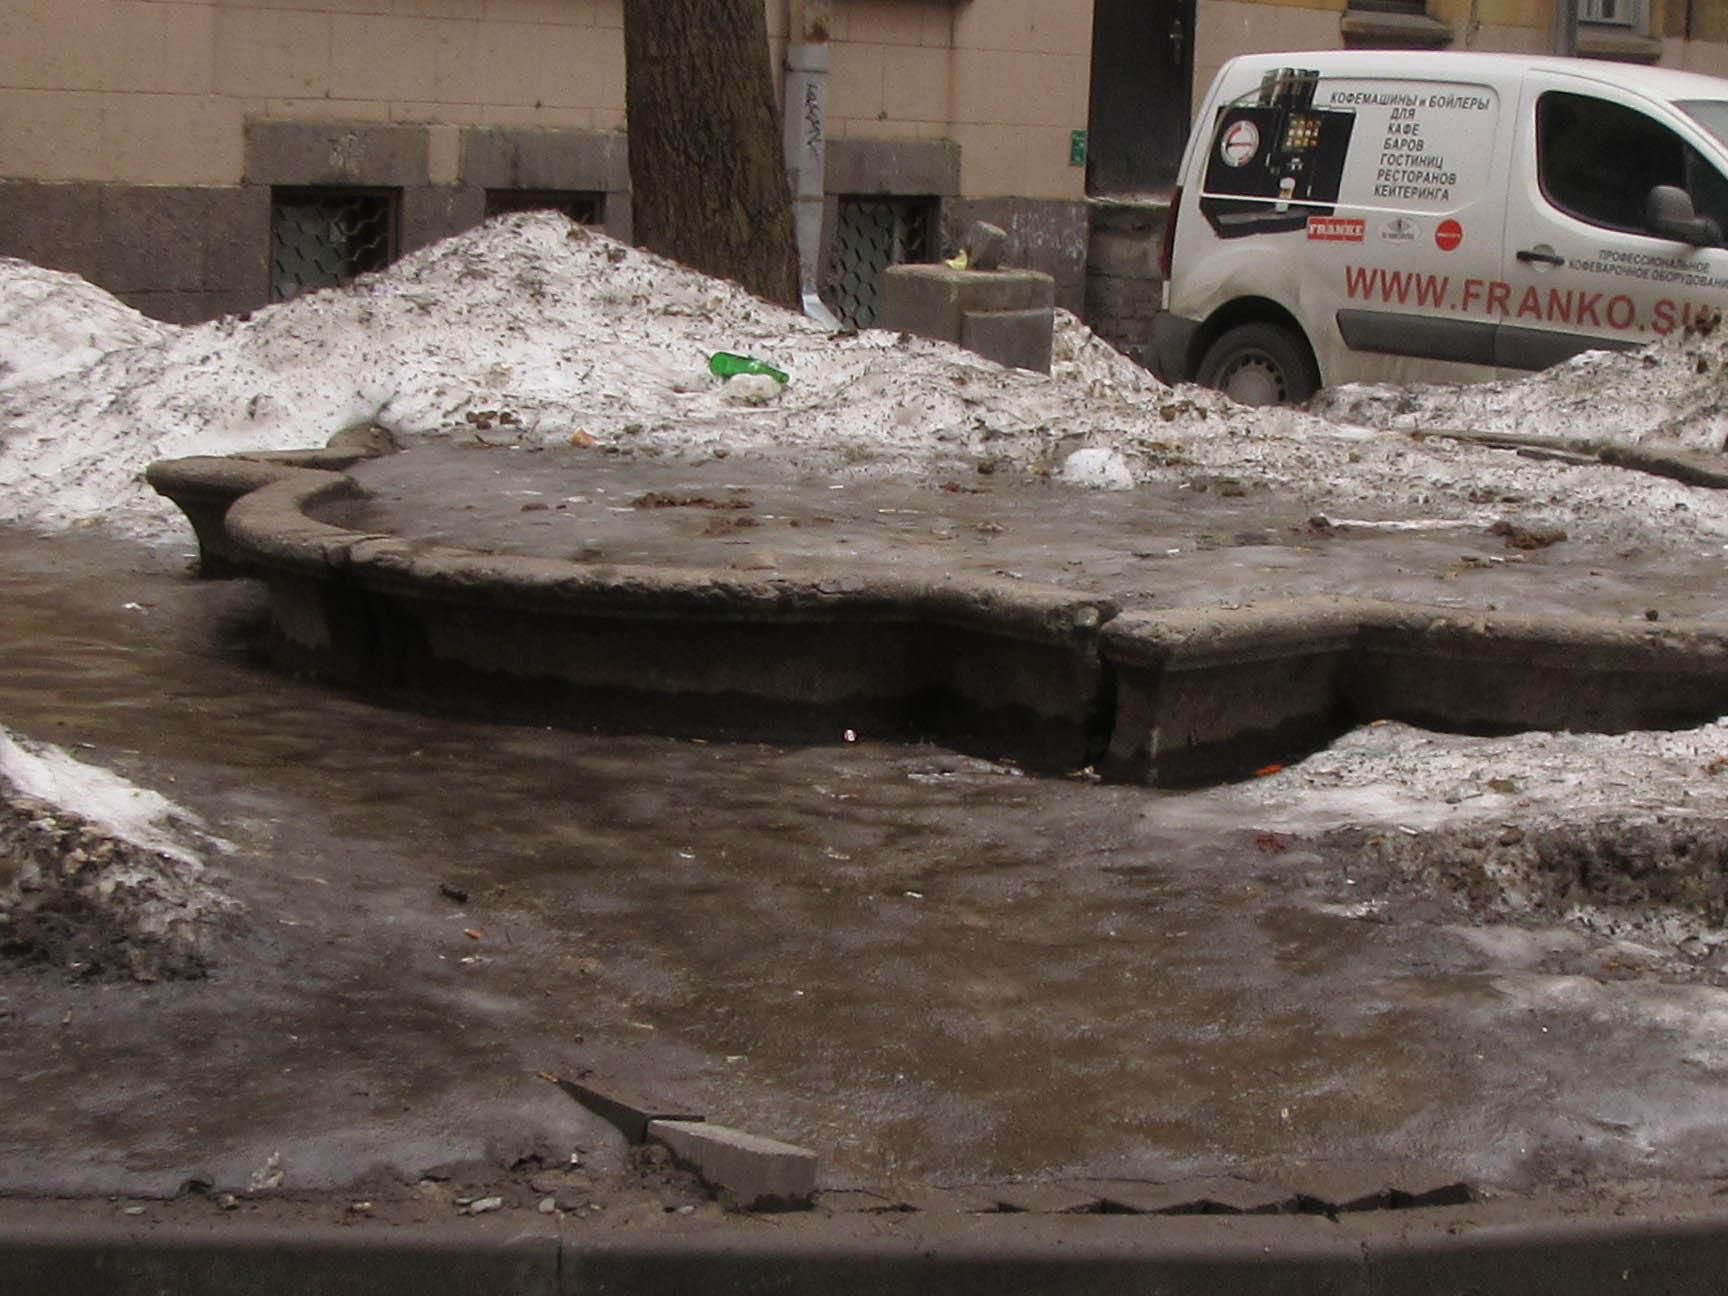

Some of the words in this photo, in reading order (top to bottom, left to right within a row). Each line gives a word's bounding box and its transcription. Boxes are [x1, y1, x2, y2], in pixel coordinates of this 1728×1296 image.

[1330, 92, 1418, 106] КОФЕМАШИНЫ
[1428, 95, 1490, 110] БОЙЛЕРЫ
[1390, 108, 1416, 121] ДЛЯ
[1387, 123, 1420, 137] КАФЕ
[1383, 138, 1424, 152] БАРОВ
[1380, 153, 1444, 170] ГОСТИНИЦ
[1376, 168, 1457, 185] РЕСТОРАНОВ
[1308, 222, 1365, 237] FRANKE
[1599, 248, 1711, 274] ПРОФЕССИОНАЛЬНОЕ
[1567, 259, 1650, 281] КОФЕВАРОЧНОЕ
